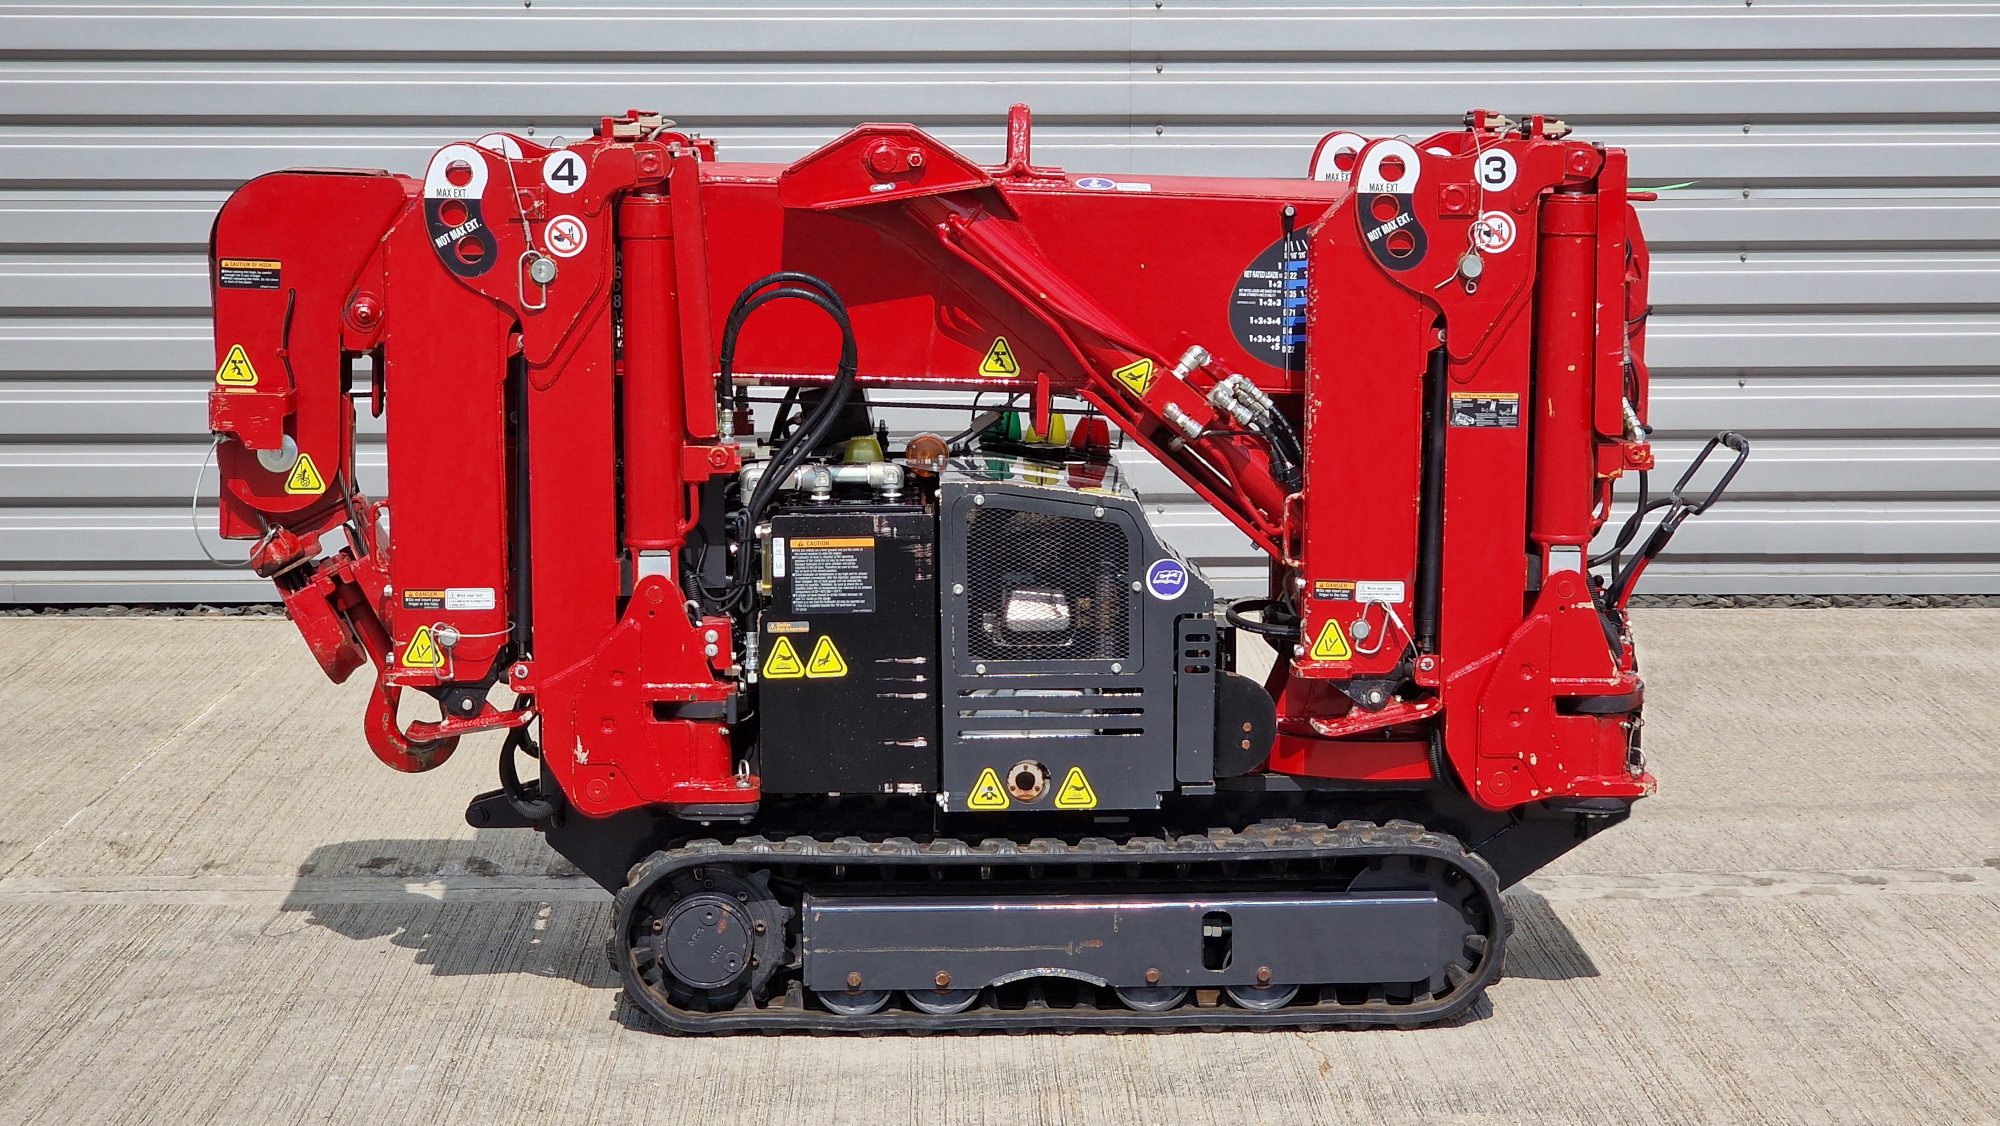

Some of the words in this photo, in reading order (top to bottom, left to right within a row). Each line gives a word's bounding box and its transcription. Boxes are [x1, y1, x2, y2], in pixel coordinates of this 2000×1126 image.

[551, 158, 578, 186] 4
[1484, 156, 1506, 184] 3
[1326, 172, 1340, 182] MAX
[1369, 183, 1384, 192] MAX
[1386, 183, 1400, 192] EXT.
[436, 188, 452, 198] MAX
[454, 188, 469, 198] EXT.
[1366, 227, 1382, 242] NOT
[1381, 220, 1398, 234] MAX
[1396, 212, 1414, 227] EXT.
[434, 233, 451, 248] NOT
[449, 225, 468, 240] MAX
[464, 218, 482, 232] EXT.
[1244, 270, 1252, 278] NET
[1252, 270, 1265, 278] RATED
[1266, 270, 1278, 278] LOADS
[1259, 298, 1282, 306] 1+2+3
[1250, 317, 1281, 325] 1+2+3+4
